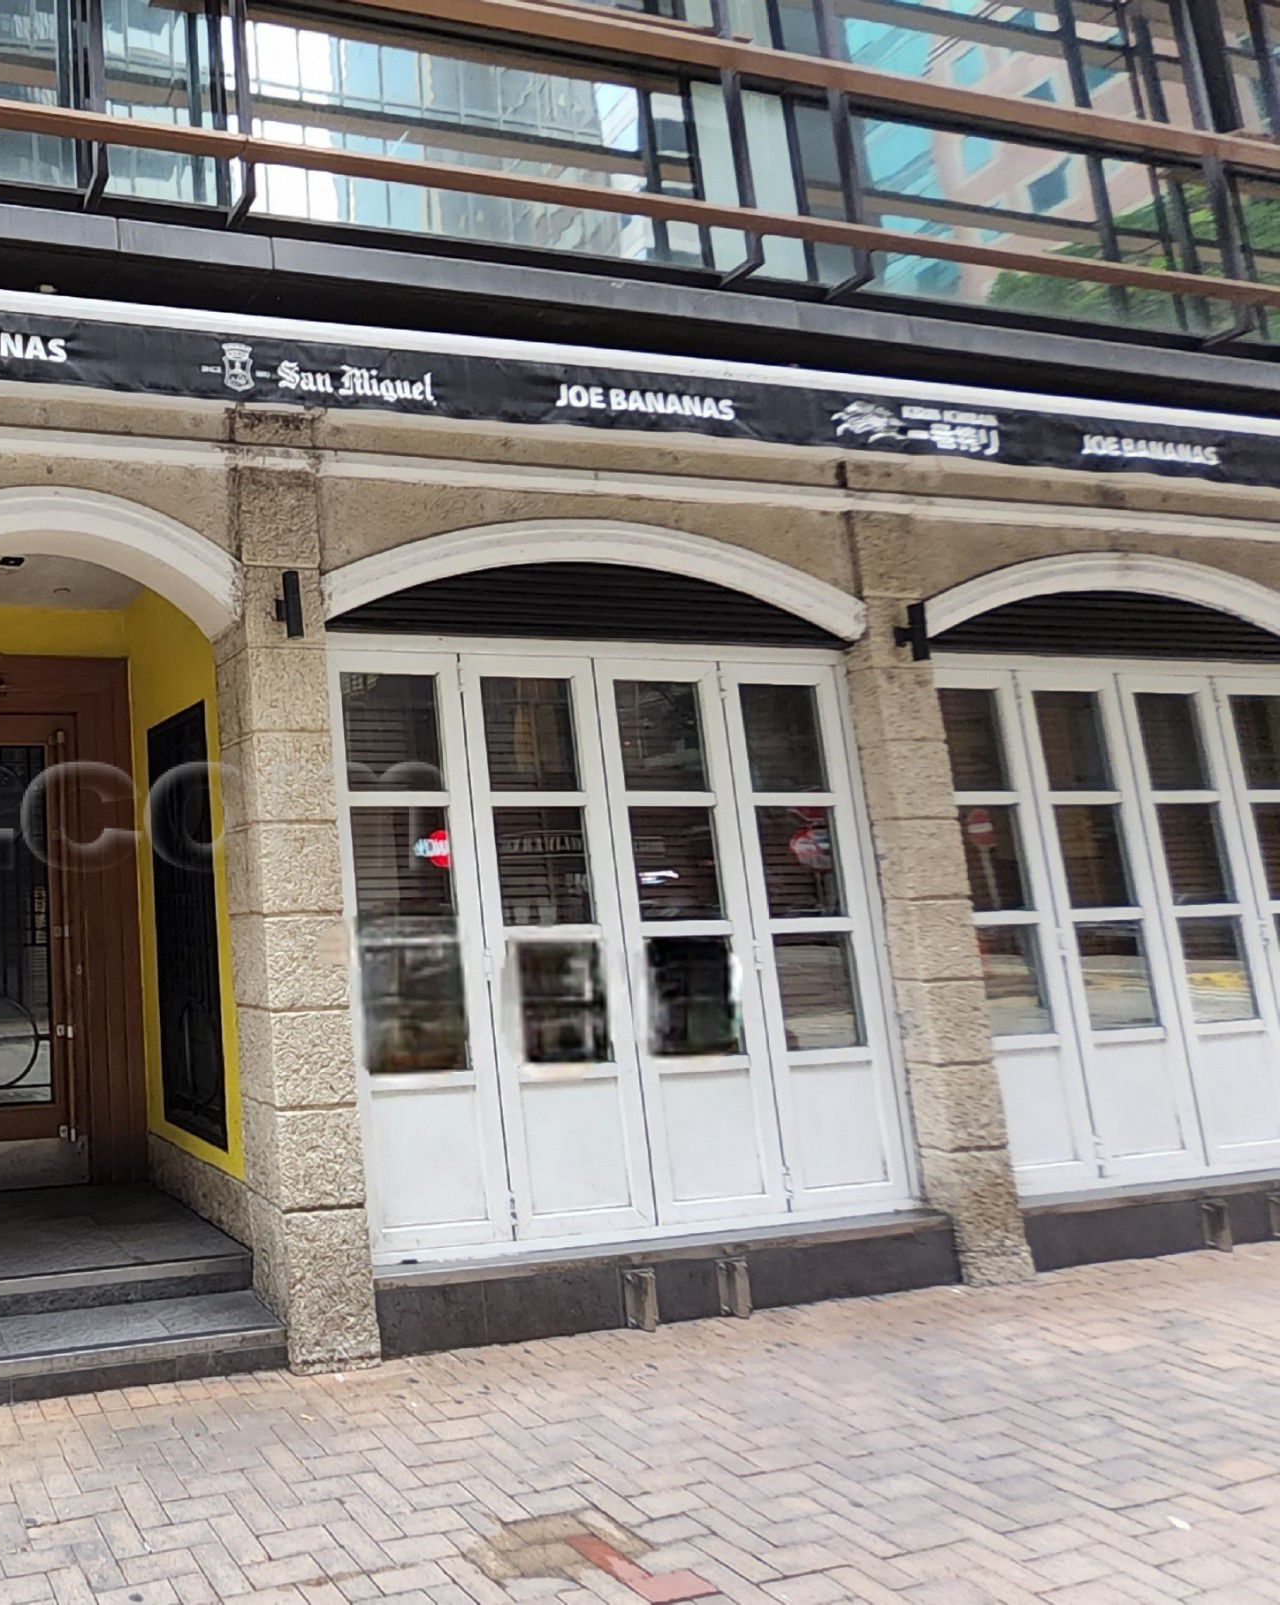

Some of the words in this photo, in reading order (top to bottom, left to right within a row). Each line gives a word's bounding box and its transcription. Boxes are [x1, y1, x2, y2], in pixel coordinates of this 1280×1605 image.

[277, 360, 333, 393] San
[339, 364, 437, 406] Miguel
[556, 384, 606, 408] JOE
[609, 388, 735, 422] BANANAS
[1081, 434, 1120, 456] JOE
[1121, 438, 1221, 466] BANANAS
